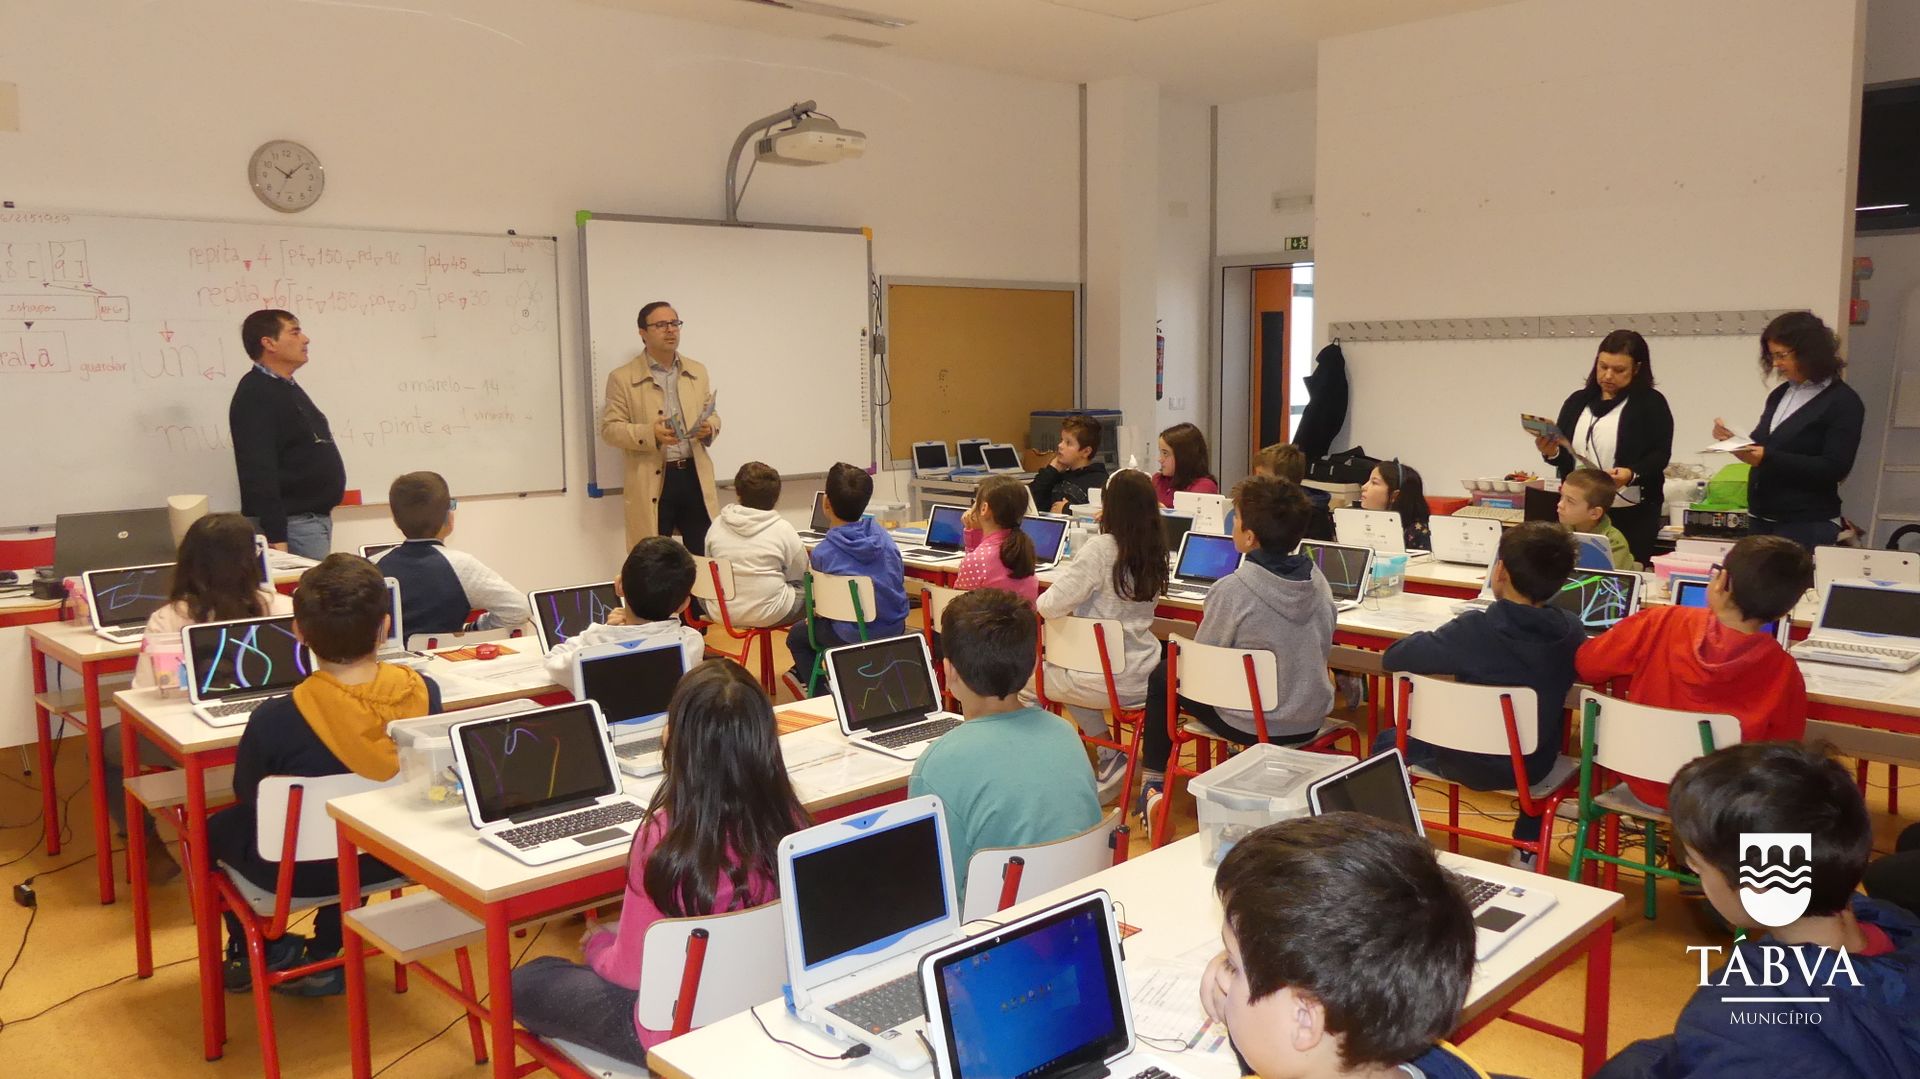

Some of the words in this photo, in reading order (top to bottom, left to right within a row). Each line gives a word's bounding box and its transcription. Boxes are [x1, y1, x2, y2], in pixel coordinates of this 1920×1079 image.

[187, 238, 240, 272] repita
[450, 256, 467, 271] 45
[397, 377, 461, 393] amarelo
